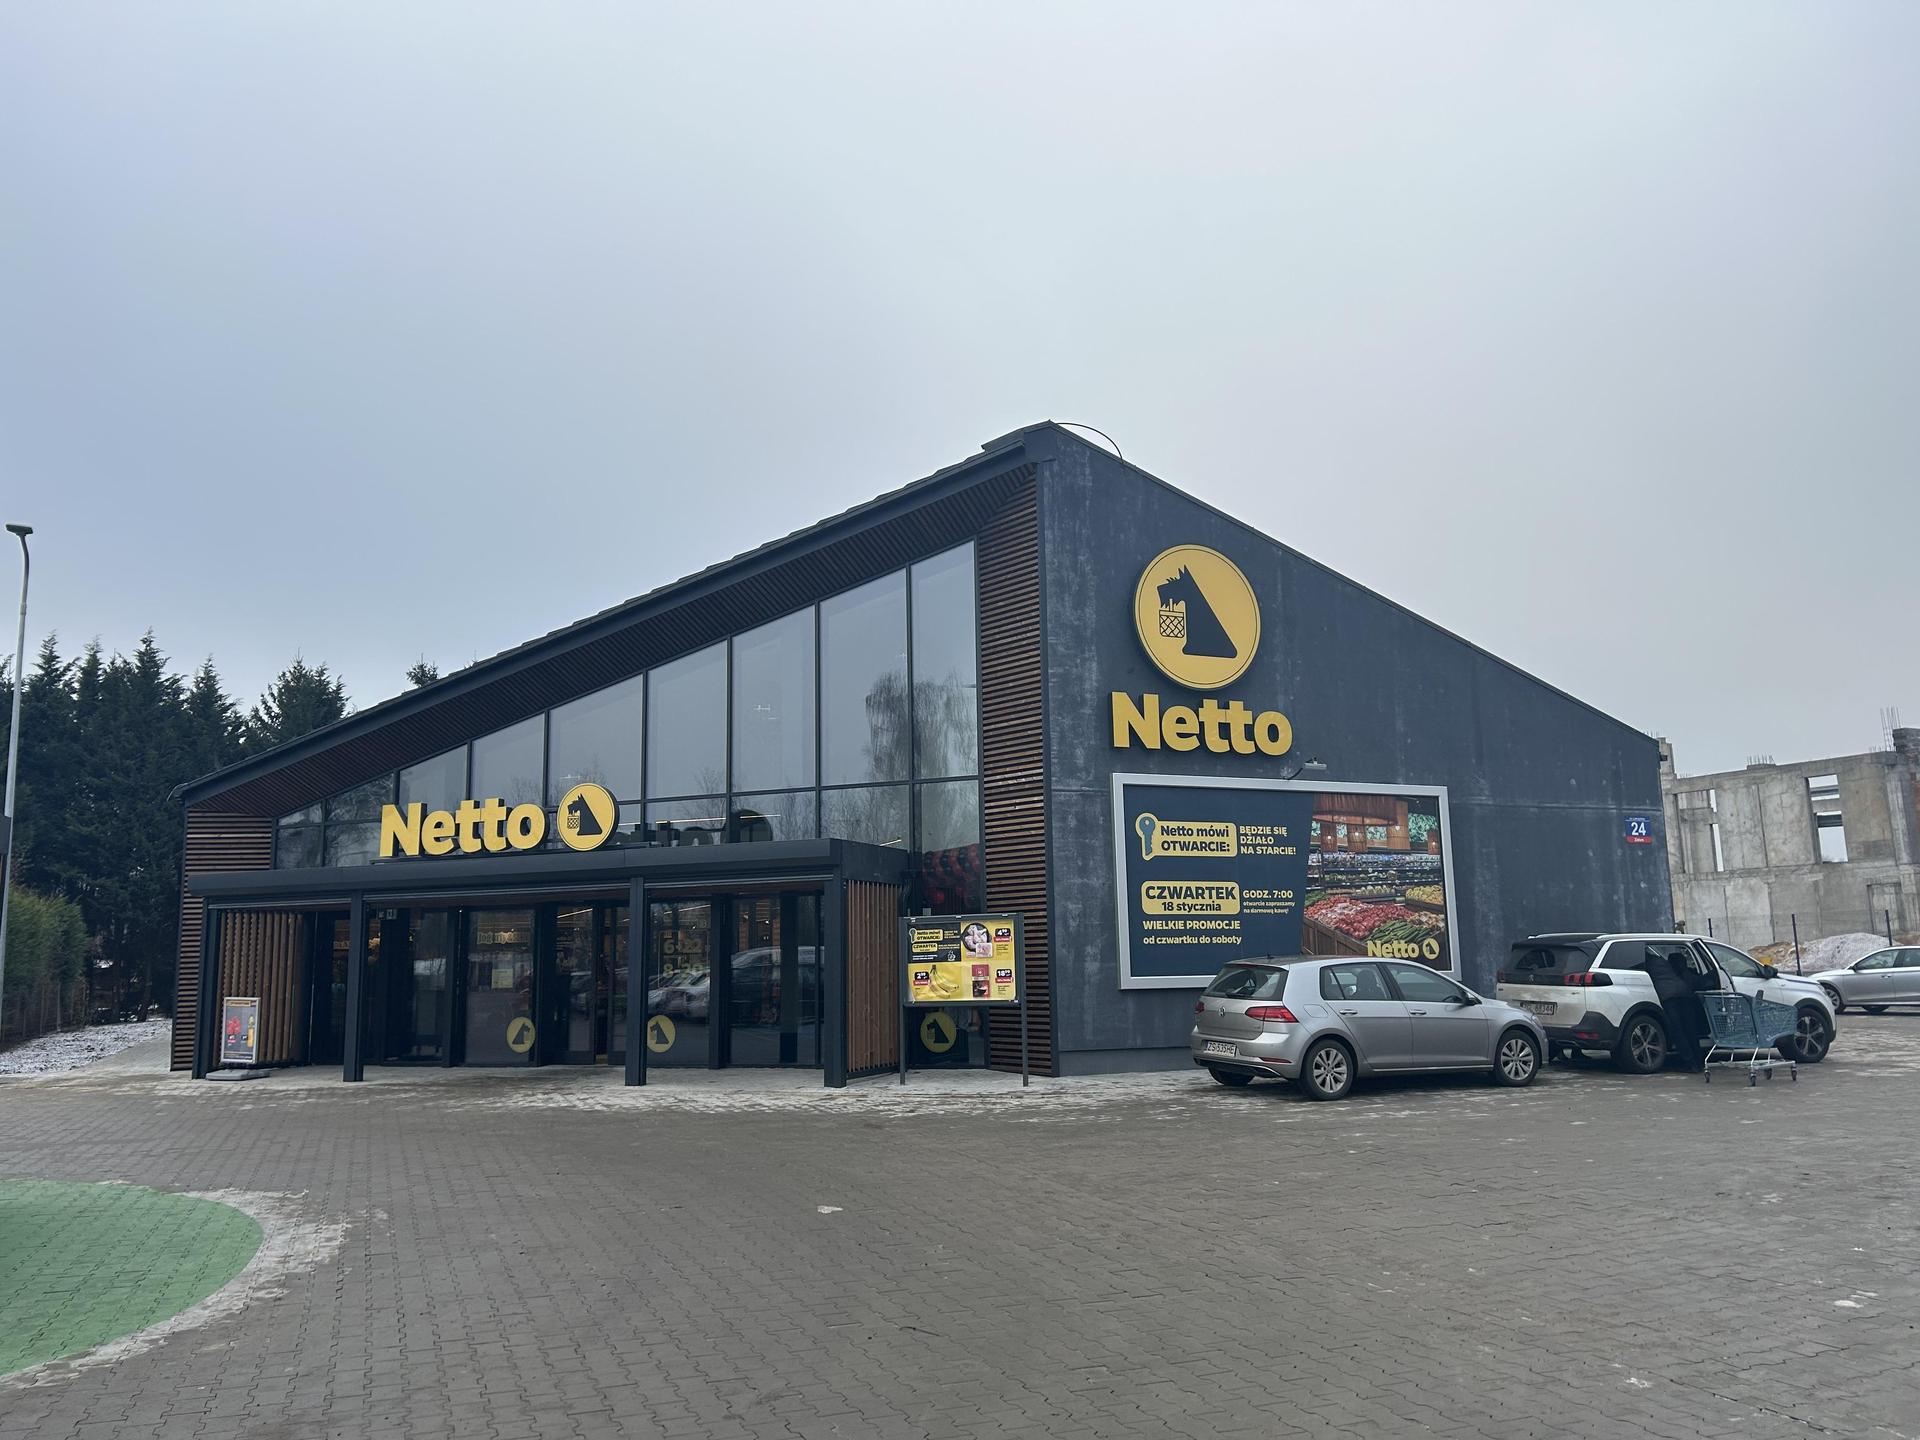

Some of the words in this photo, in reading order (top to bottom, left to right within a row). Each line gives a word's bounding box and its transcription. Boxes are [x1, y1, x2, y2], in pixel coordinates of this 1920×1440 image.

[1111, 691, 1293, 756] Netto
[379, 798, 547, 857] Netto
[1160, 825, 1194, 837] Netto
[1196, 824, 1229, 838] mówi
[1239, 825, 1272, 837] BĘDZIE
[1273, 826, 1287, 837] SIĘ
[1631, 822, 1646, 836] 24
[1160, 840, 1230, 852] OTWARCIE:
[1240, 836, 1274, 845] DZIAŁO
[1240, 846, 1254, 854] NA
[1255, 846, 1296, 855] STARCIE!
[1145, 885, 1236, 900] CZWARTEK
[1242, 890, 1271, 899] GODZ.
[1272, 890, 1293, 899] 7:00
[1161, 902, 1173, 911] 18
[1176, 901, 1221, 913] stycznia
[1143, 920, 1185, 930] WIELKIE
[1186, 920, 1241, 930] PROMOCJE
[1143, 935, 1155, 944] od
[1156, 935, 1198, 945] czwartku
[1199, 935, 1211, 944] do
[1211, 934, 1242, 945] soboty
[1366, 940, 1420, 958] Netto
